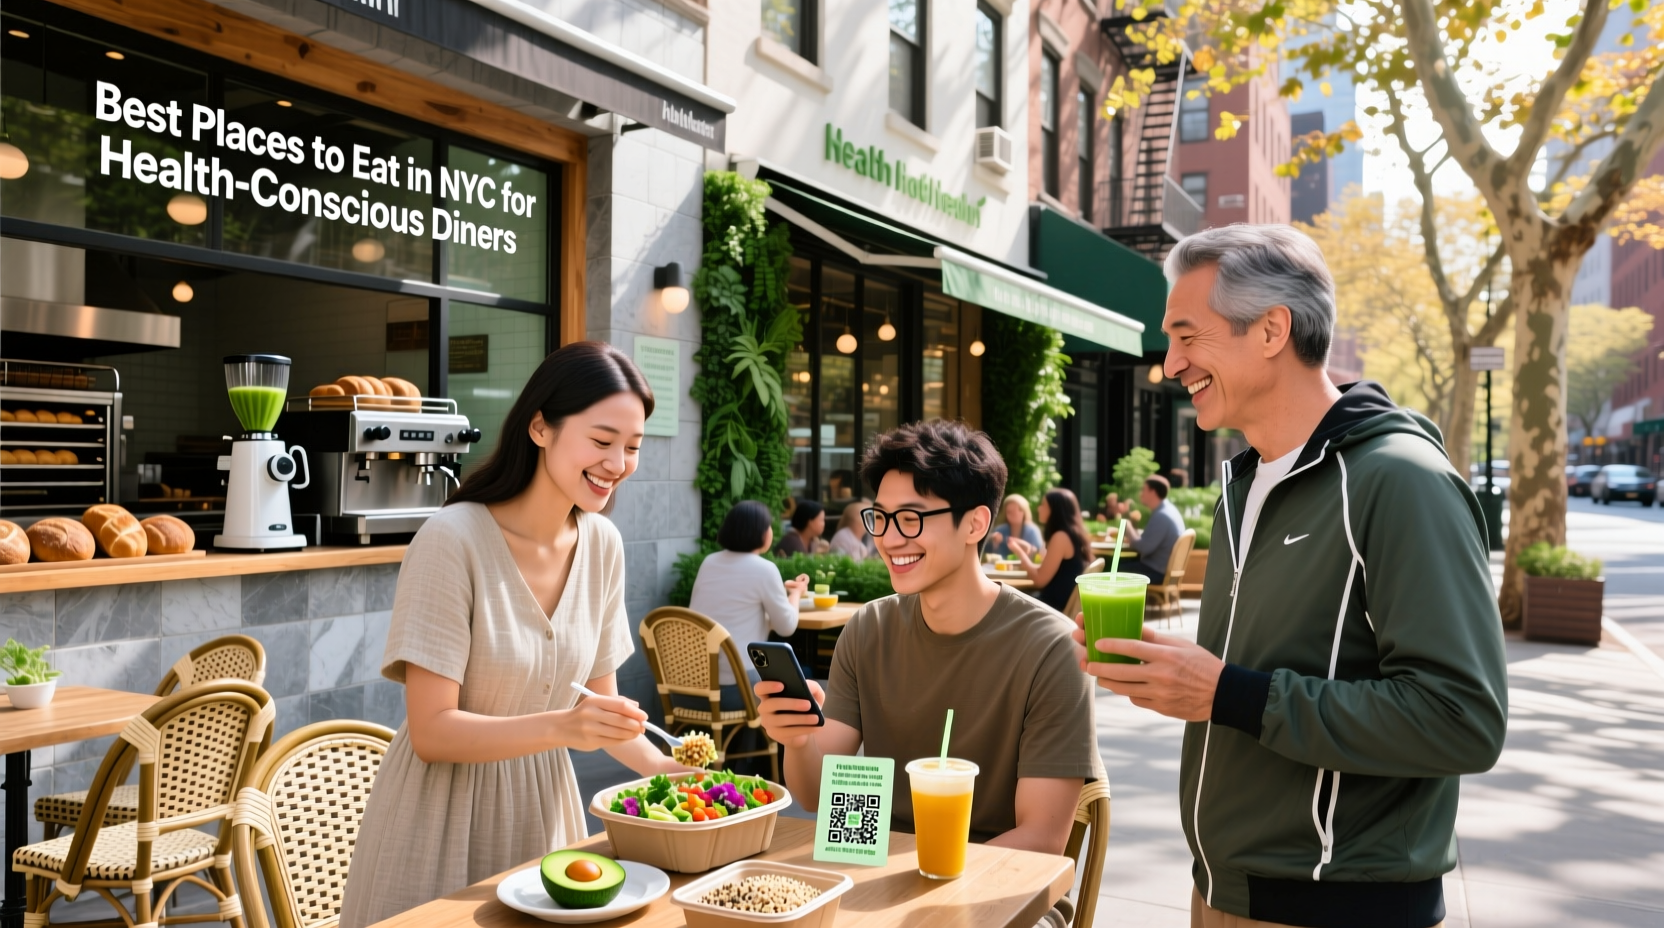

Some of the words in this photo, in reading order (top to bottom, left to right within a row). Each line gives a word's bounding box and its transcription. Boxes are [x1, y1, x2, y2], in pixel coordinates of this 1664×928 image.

[96, 80, 183, 138] Best
[192, 103, 305, 165] Places
[311, 135, 345, 173] to
[352, 143, 400, 188] Eat
[407, 156, 432, 195] in
[440, 166, 496, 209] NYC
[501, 181, 536, 218] for
[101, 134, 425, 237] Health-Conscious
[432, 207, 517, 255] Diners
